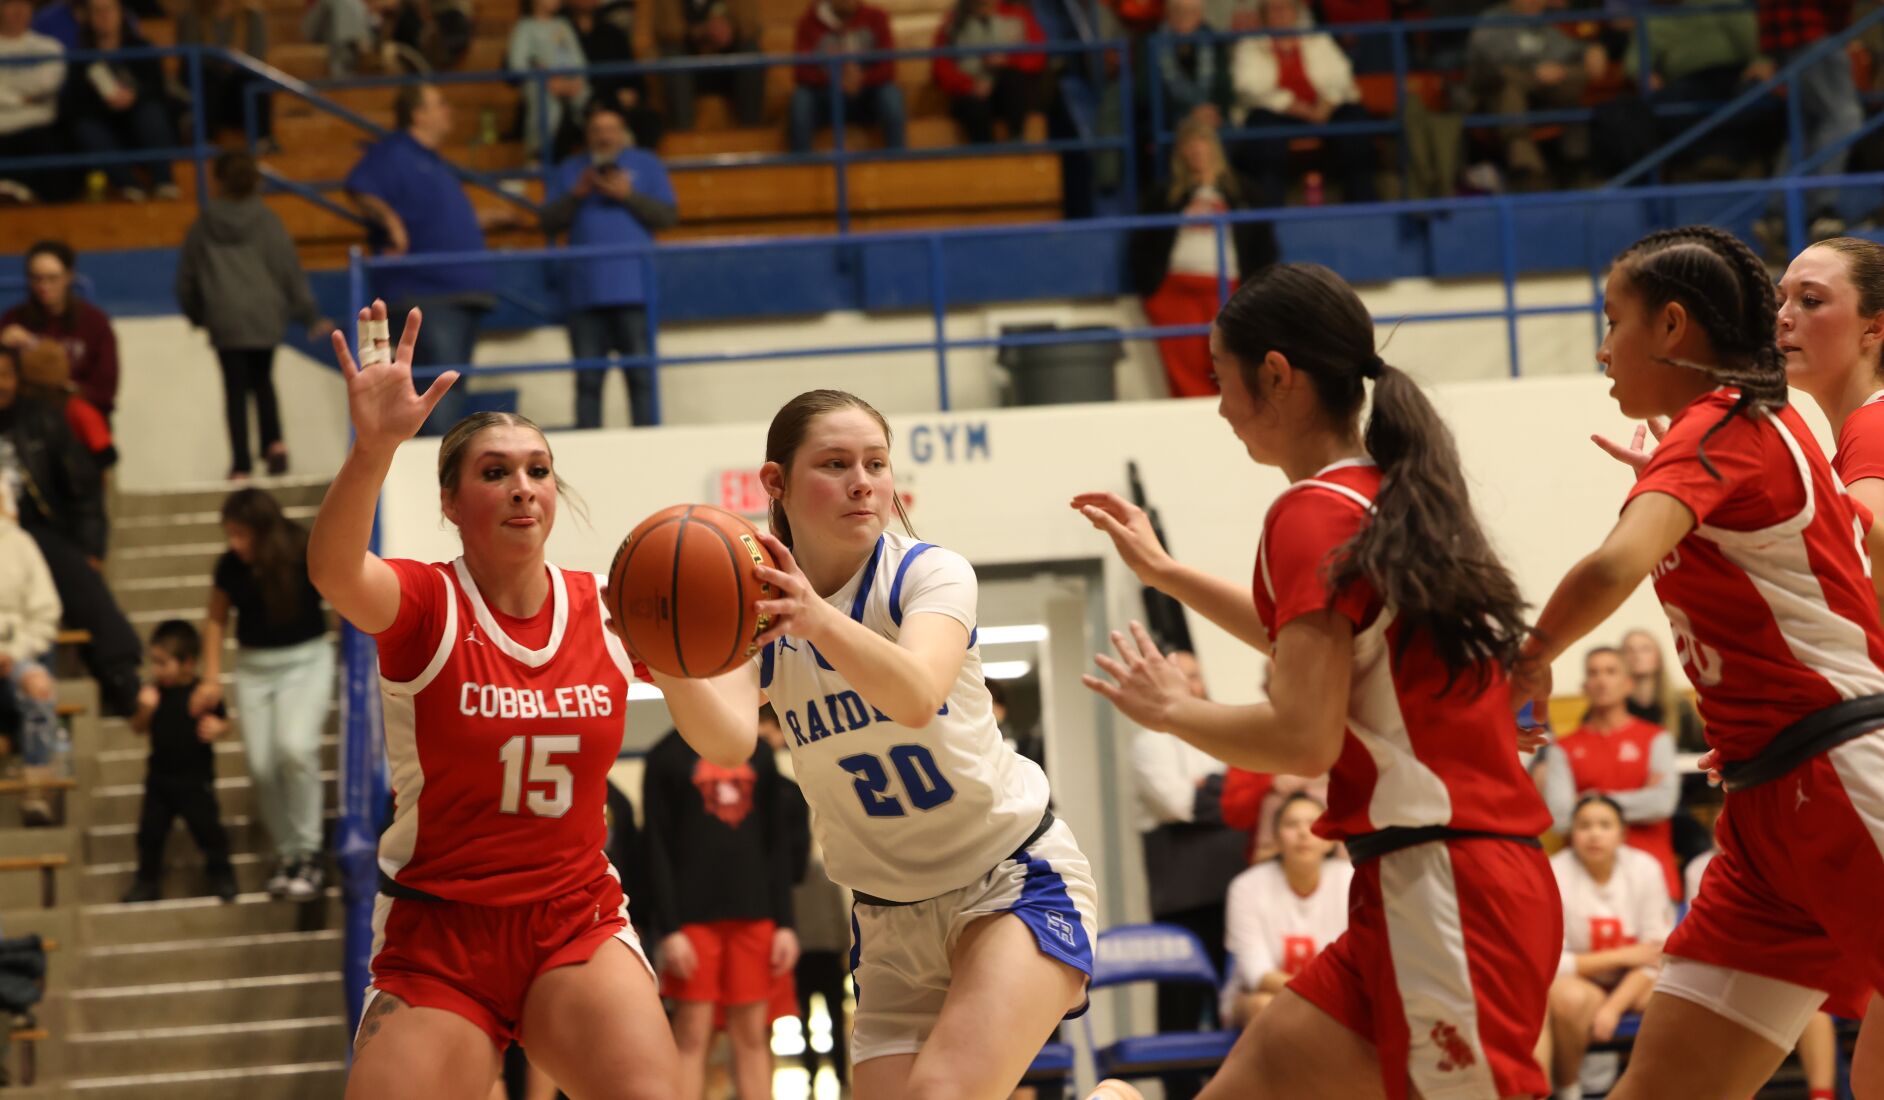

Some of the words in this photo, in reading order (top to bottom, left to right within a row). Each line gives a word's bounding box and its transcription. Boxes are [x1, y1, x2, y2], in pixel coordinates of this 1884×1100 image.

[909, 422, 990, 463] GYM
[721, 470, 769, 512] EXI
[459, 681, 612, 719] COBBLERS
[499, 734, 581, 818] 15
[837, 743, 957, 818] 20
